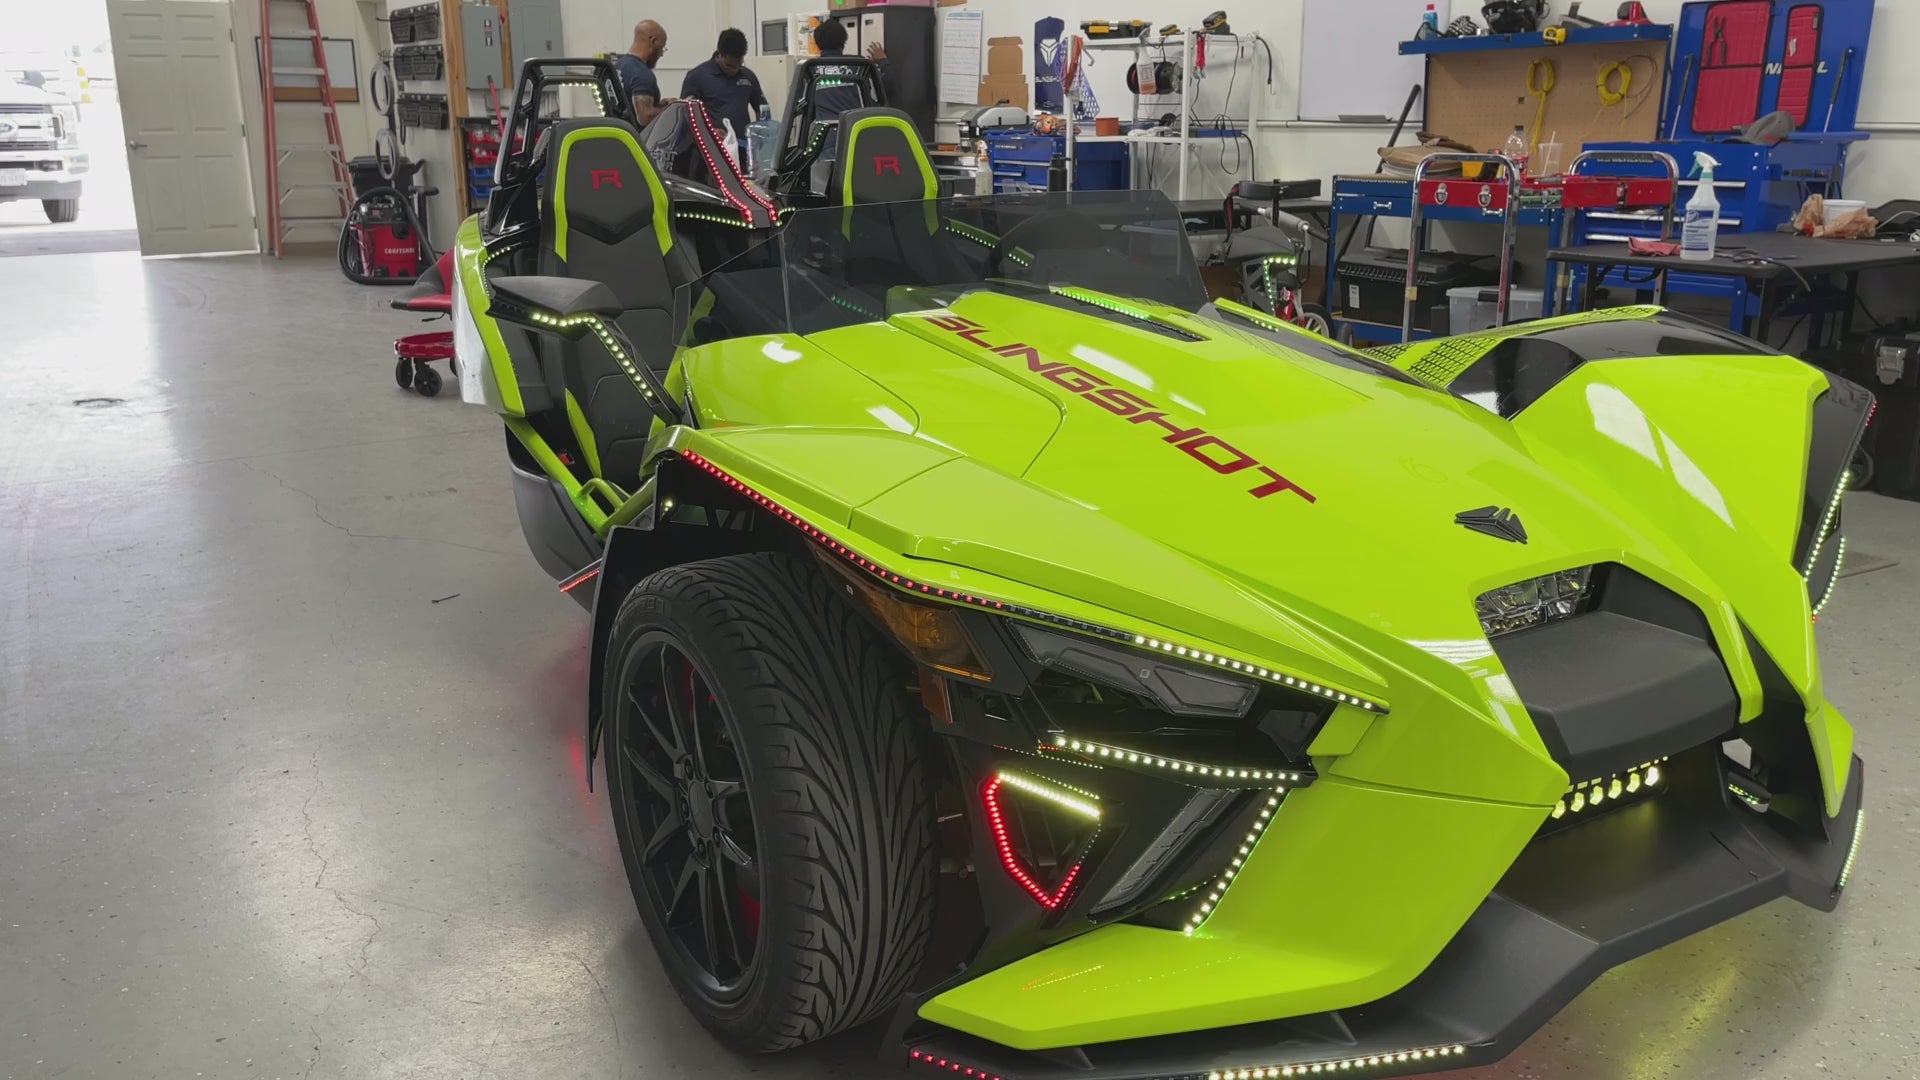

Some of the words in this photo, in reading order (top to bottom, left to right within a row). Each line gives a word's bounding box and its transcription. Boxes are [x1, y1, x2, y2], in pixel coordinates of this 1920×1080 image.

[875, 155, 901, 175] R
[590, 169, 624, 189] R
[924, 316, 1317, 505] SLINGSHOT
